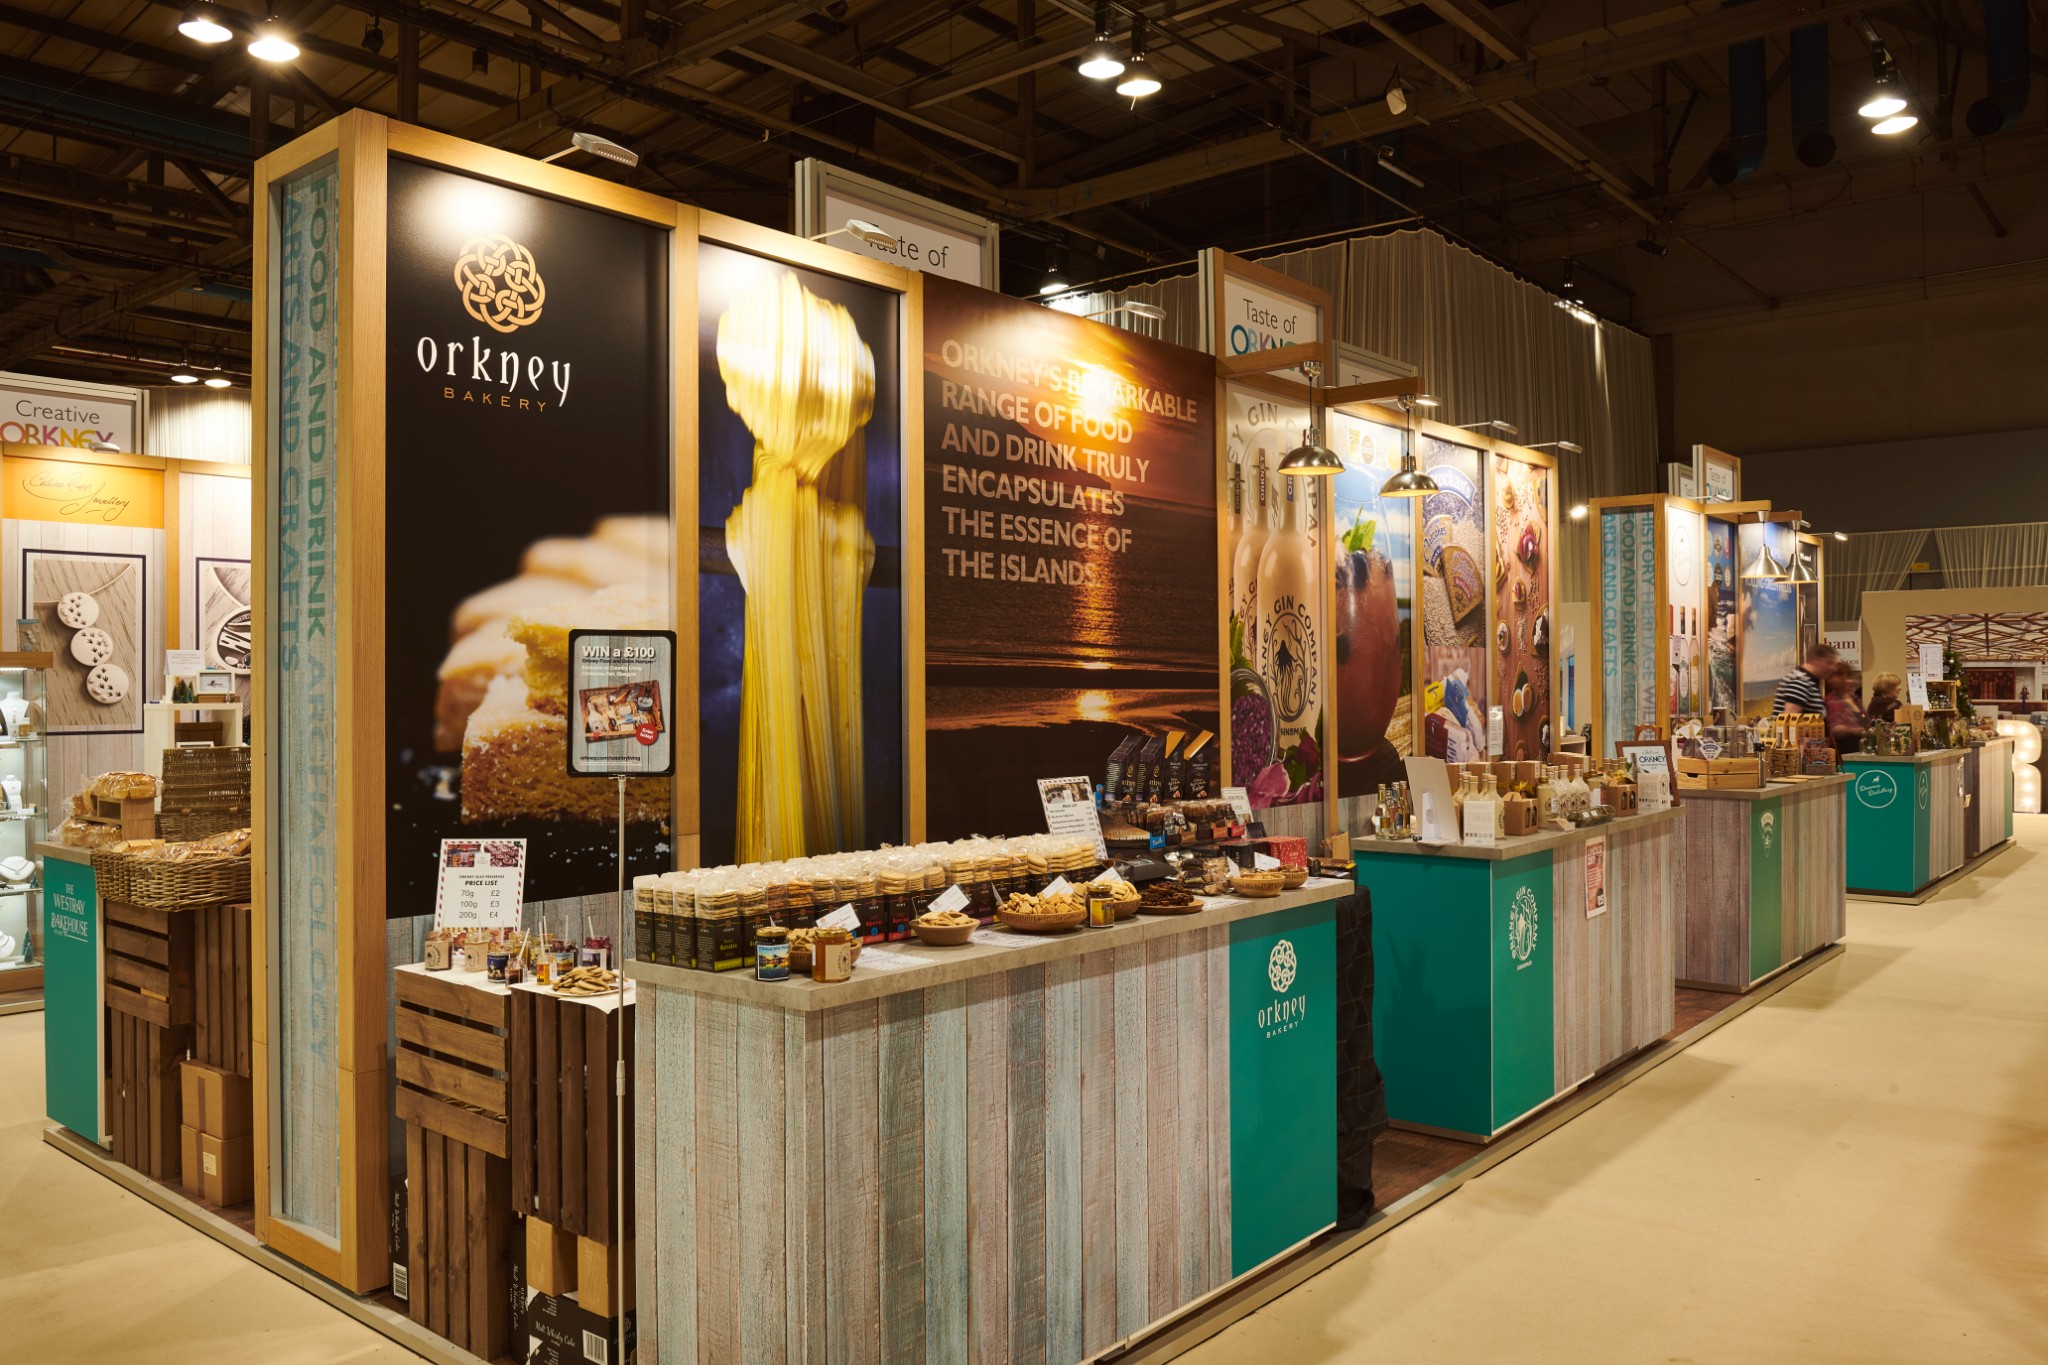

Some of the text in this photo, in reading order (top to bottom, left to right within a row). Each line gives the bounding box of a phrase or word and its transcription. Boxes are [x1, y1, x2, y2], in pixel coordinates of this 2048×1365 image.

[309, 178, 328, 332] FOOD
[928, 246, 950, 269] of
[1243, 298, 1298, 335] Taste of
[417, 335, 571, 408] orkney
[941, 338, 1198, 424] ORKNEY'S REMARKABLE
[16, 399, 101, 425] Creative
[308, 346, 326, 464] AND
[443, 387, 547, 413] BAKERY
[941, 379, 1133, 444] RANGE OF FOOD
[1246, 402, 1279, 428] GIN
[0, 421, 115, 450] ORKNEY
[280, 197, 303, 673] ARTS AND CRAFTS
[941, 423, 1150, 483] AND DRINK TRULY
[942, 464, 1125, 516] ENCAPSULATES
[941, 505, 1133, 553] THE ESSENCE OF
[307, 476, 326, 642] DRINK
[941, 548, 995, 580] THE
[1641, 512, 1655, 587] HISTORY
[1603, 514, 1618, 678] ARTS AND CRAFTS
[1622, 566, 1636, 607] AND
[582, 645, 656, 659] WIN a £100
[1274, 595, 1294, 614] GIN
[1297, 603, 1318, 711] COMPANY
[1622, 610, 1636, 667] DRINK
[1641, 591, 1656, 682] HERITAGE
[1639, 755, 1666, 763] ORKNEY
[53, 893, 86, 916] WESTRAY
[65, 883, 75, 895] THE
[460, 900, 500, 909] 100g £3
[461, 889, 500, 898] 70g £2
[1515, 885, 1526, 900] GIN
[51, 912, 88, 937] BAKEHOUSE
[458, 911, 477, 920] 200g
[1258, 994, 1306, 1029] orkney
[1266, 1020, 1299, 1039] BAKERY
